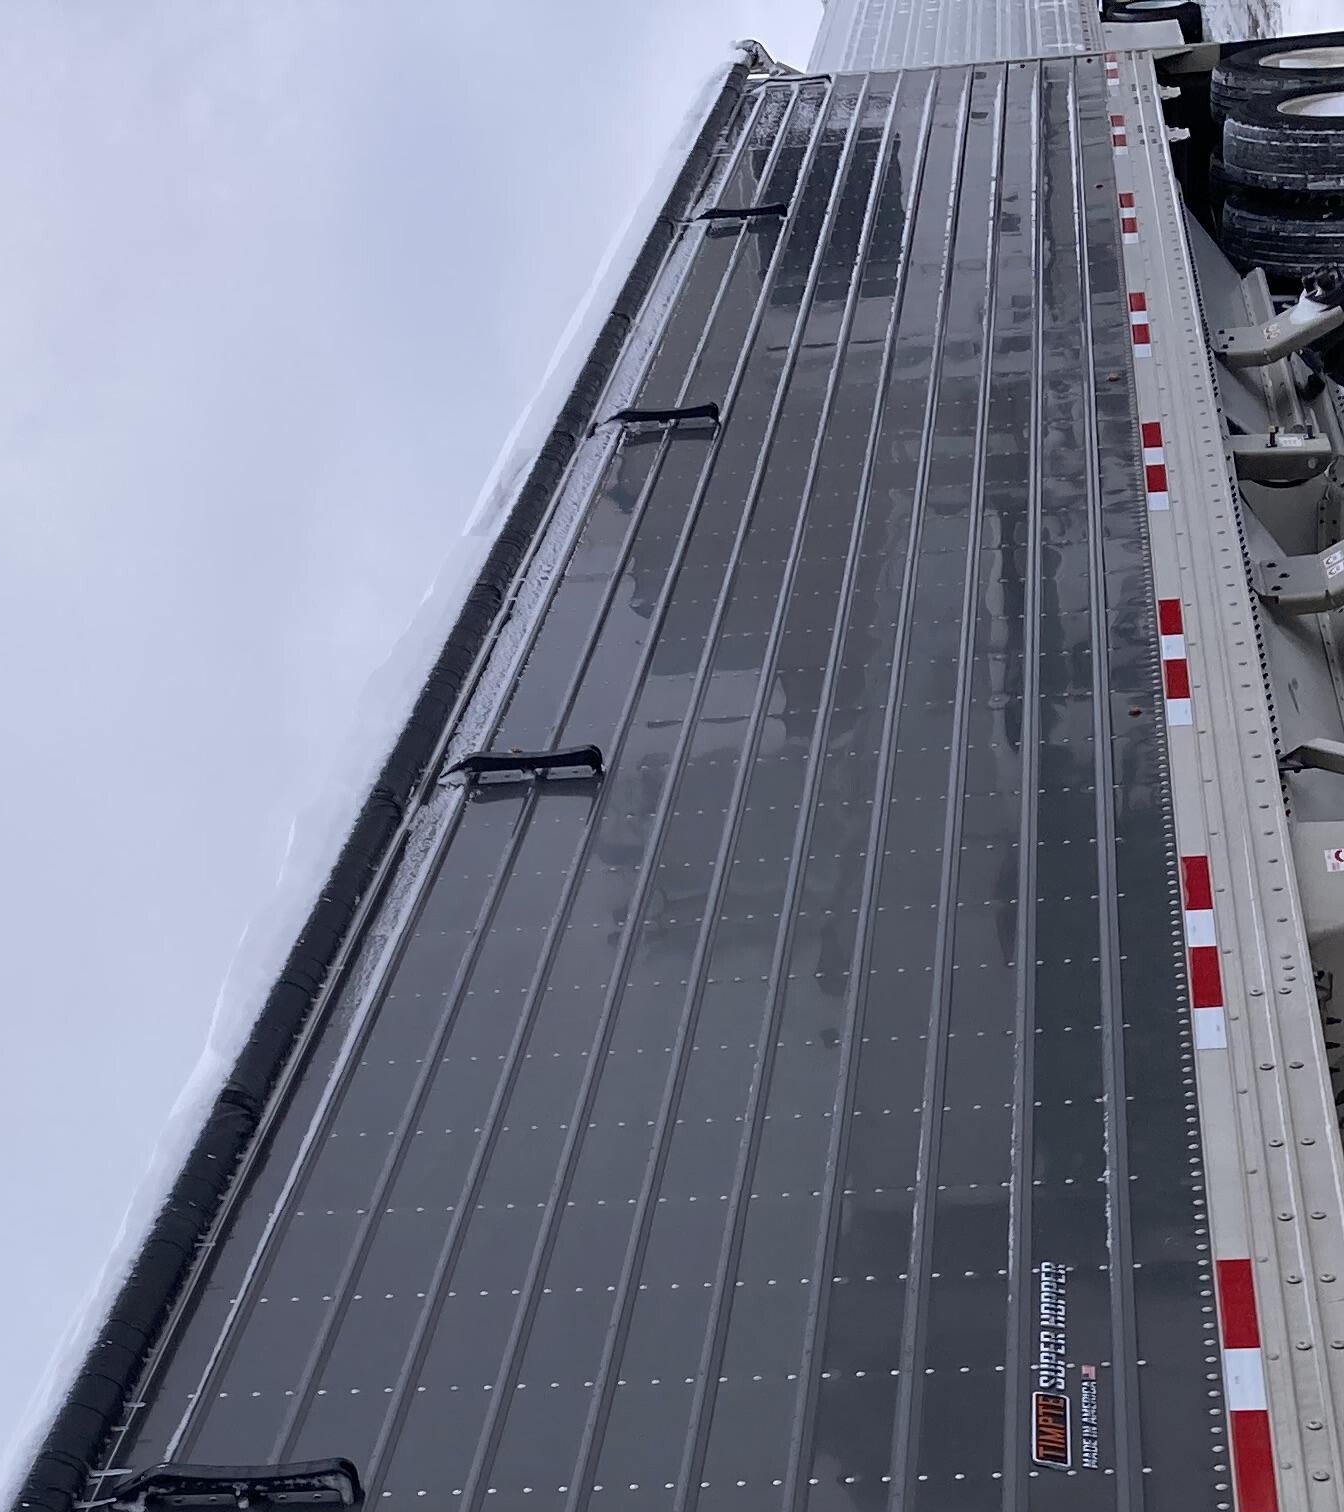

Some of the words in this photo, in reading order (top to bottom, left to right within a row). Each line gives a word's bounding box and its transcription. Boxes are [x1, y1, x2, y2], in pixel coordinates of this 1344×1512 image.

[1040, 1262, 1067, 1329] HOPPER
[1038, 1331, 1066, 1390] SUPER
[1038, 1395, 1066, 1459] TIMPTE
[1081, 1381, 1097, 1425] AMERICA
[1082, 1425, 1097, 1437] IN
[1082, 1438, 1098, 1469] MADE
